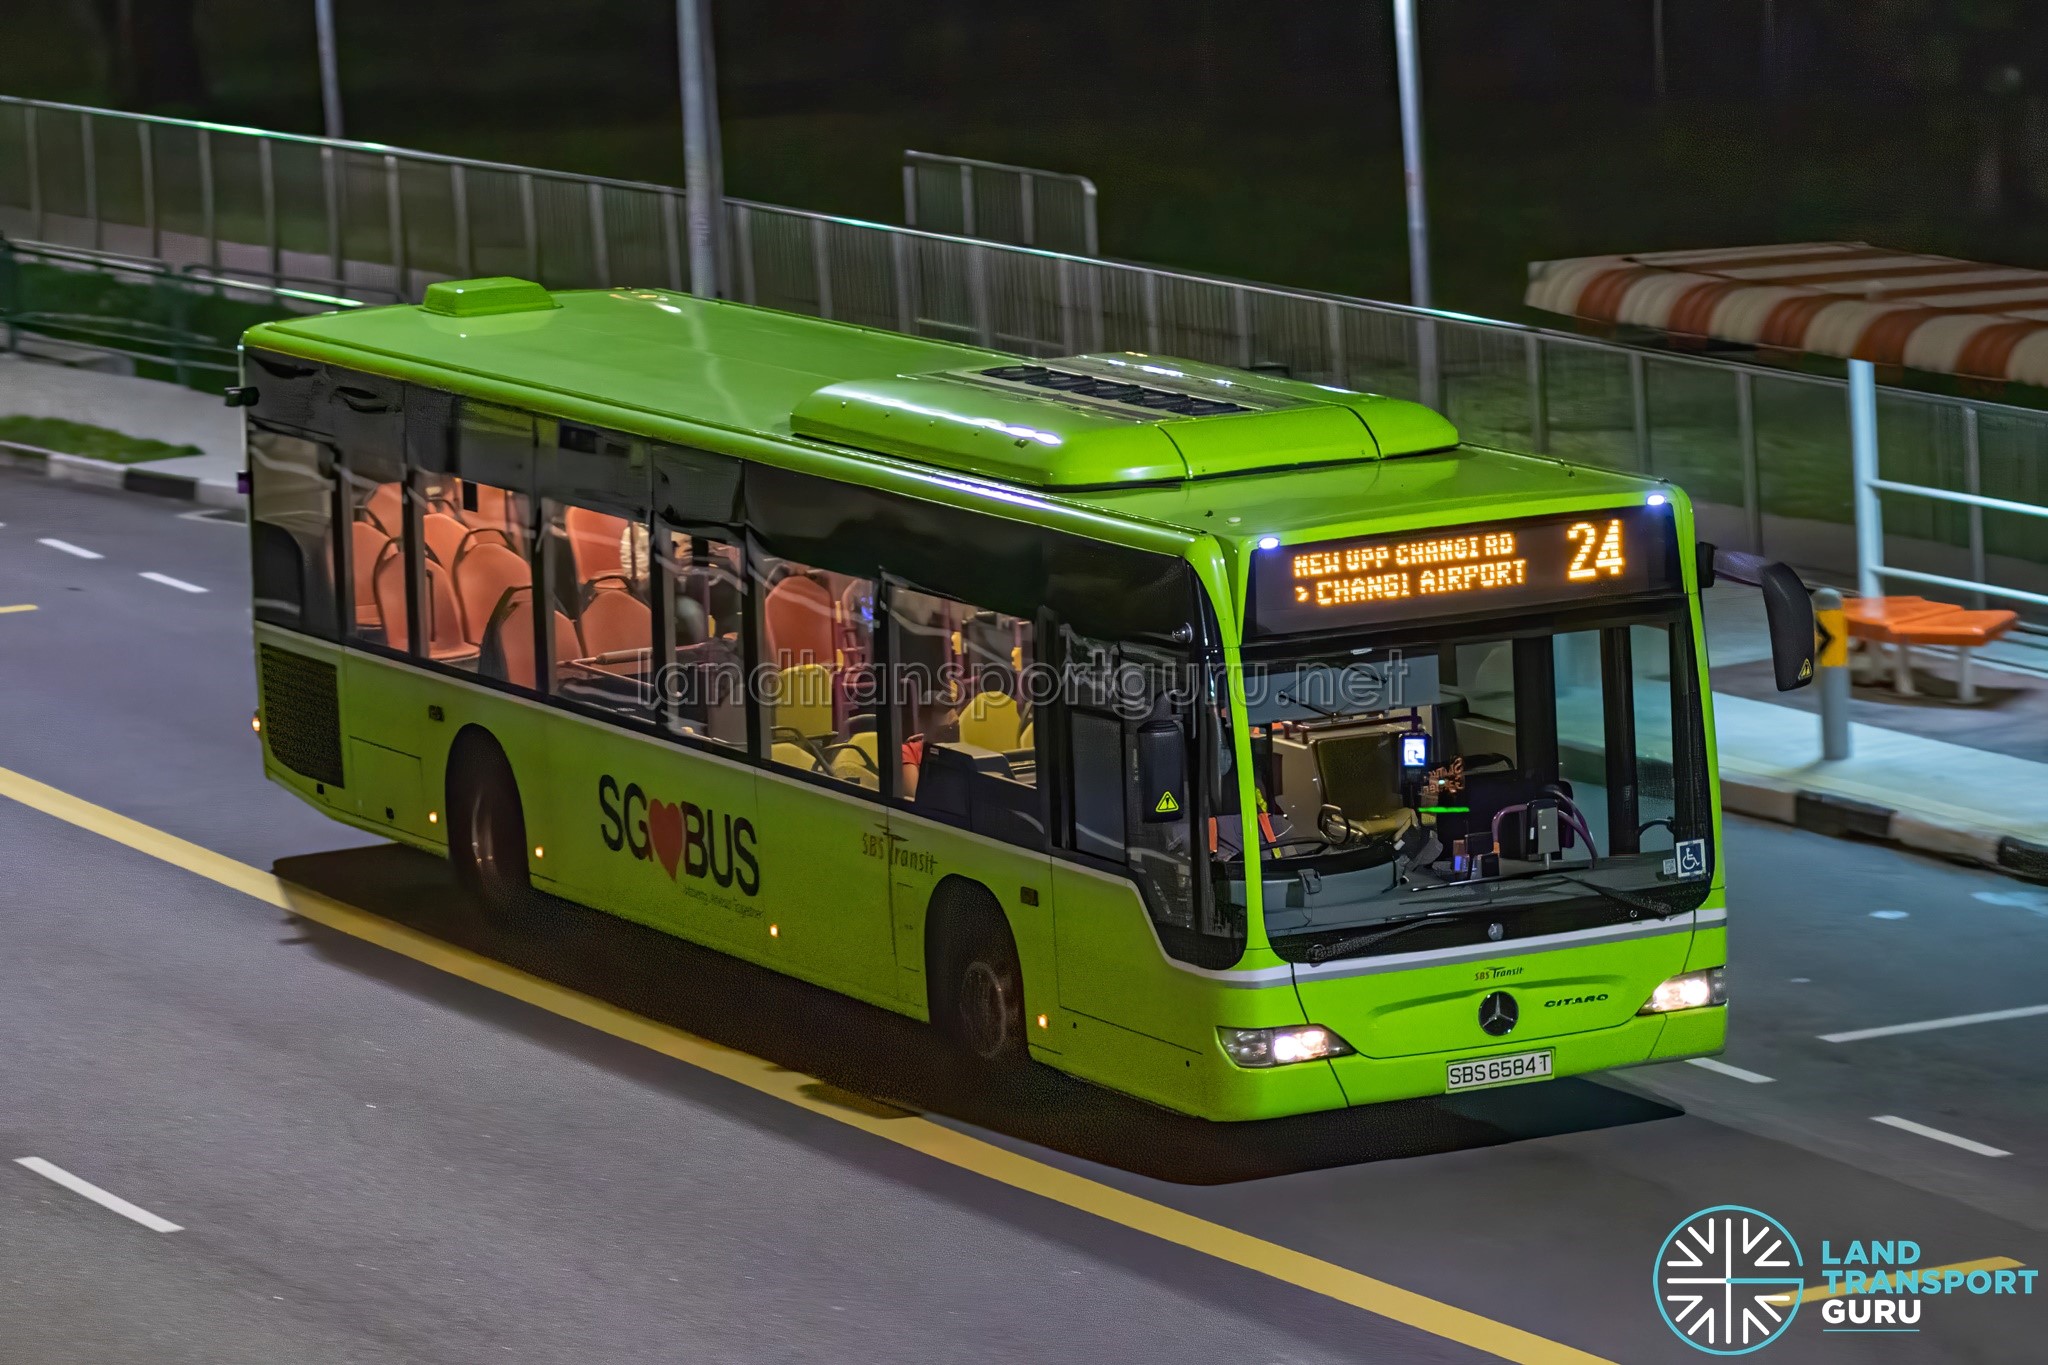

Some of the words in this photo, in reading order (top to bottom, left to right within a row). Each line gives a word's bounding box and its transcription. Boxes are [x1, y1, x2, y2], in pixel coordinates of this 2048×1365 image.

[1294, 552, 1341, 578] NEW
[1346, 546, 1389, 572] UPP
[1395, 536, 1480, 566] CHANGI
[1485, 532, 1514, 557] RD
[1566, 518, 1624, 580] 24
[1316, 572, 1411, 606] CHANGI
[1419, 558, 1527, 594] AIRPORT
[599, 774, 653, 862] SG
[680, 801, 761, 897] BUS
[862, 832, 884, 861] SBS
[876, 823, 938, 875] Transit
[1474, 973, 1490, 982] SBS
[1485, 966, 1524, 979] Transit
[1543, 993, 1609, 1009] CITARO
